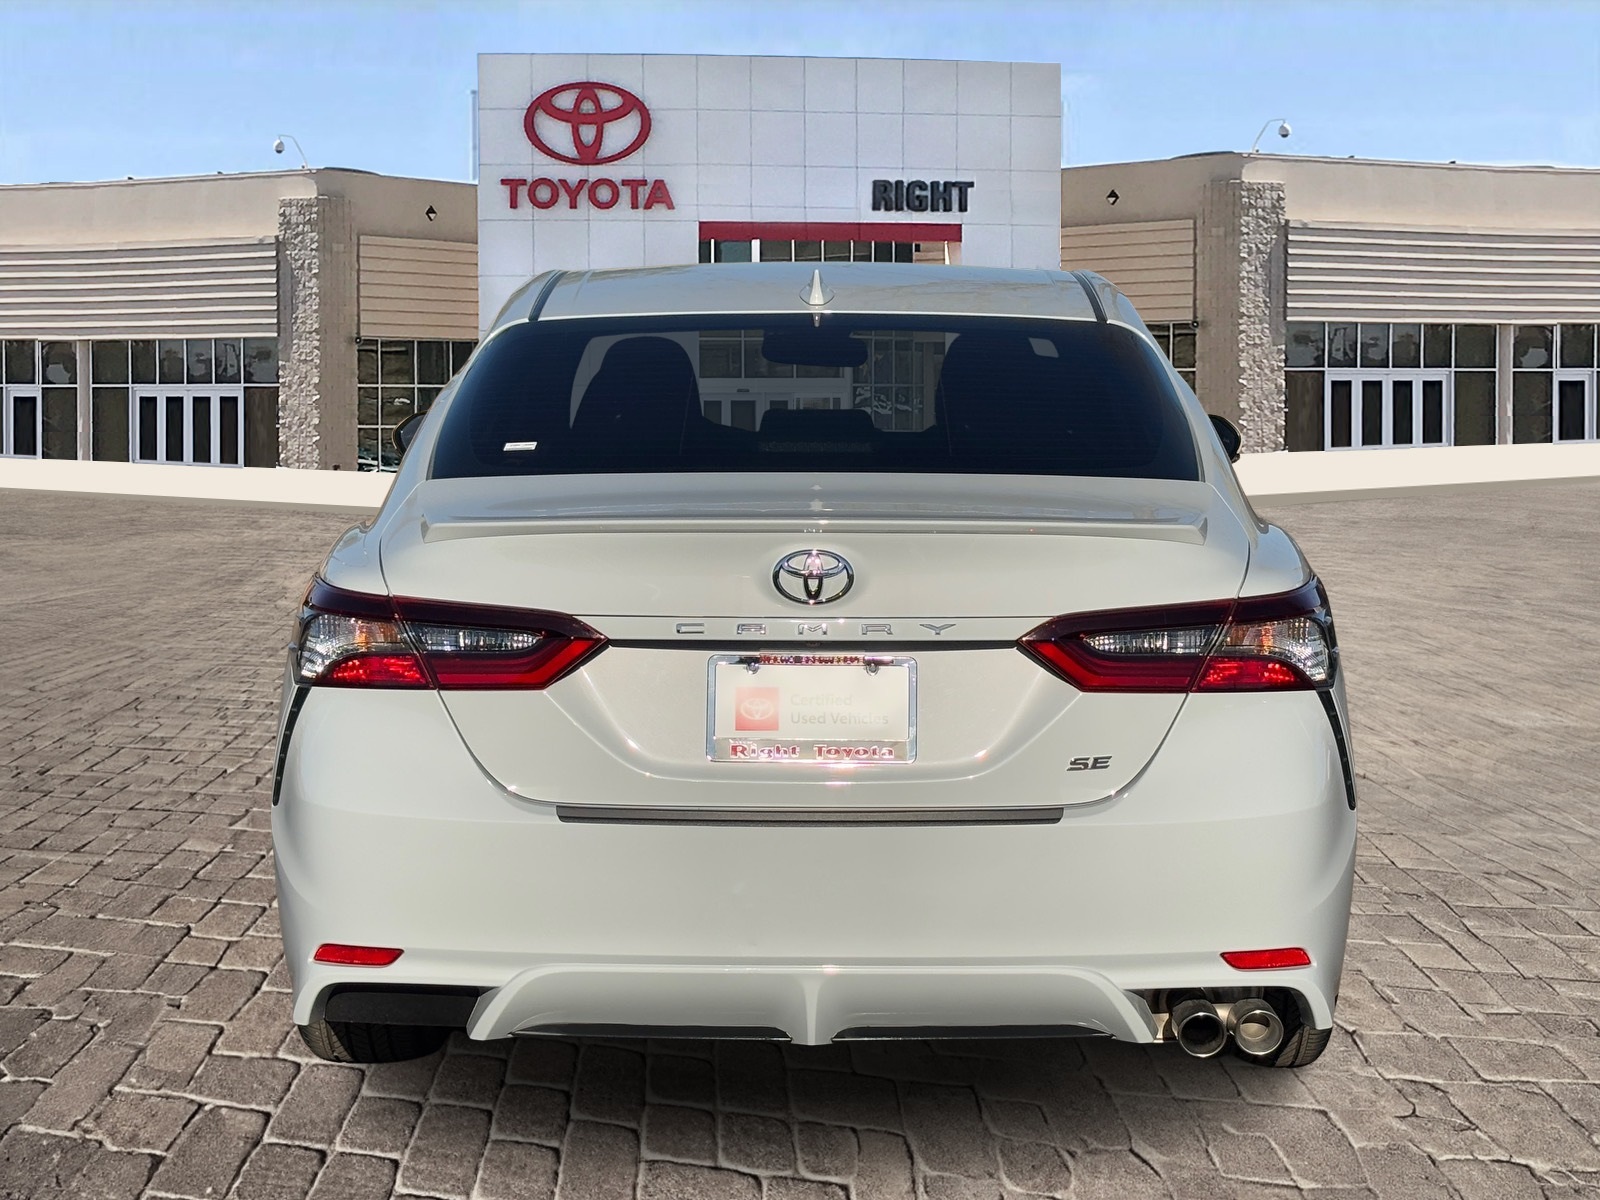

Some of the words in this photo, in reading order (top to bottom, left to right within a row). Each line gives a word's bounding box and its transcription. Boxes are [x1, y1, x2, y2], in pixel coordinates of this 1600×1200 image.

[500, 178, 675, 211] TOYOTA
[872, 180, 975, 213] RIGHT
[676, 623, 957, 635] CAMRY
[790, 694, 853, 706] Certified
[790, 712, 826, 725] Used
[831, 712, 889, 725] Vehicles
[730, 744, 800, 760] Right
[813, 744, 895, 760] Toyota
[1066, 755, 1113, 772] SE
